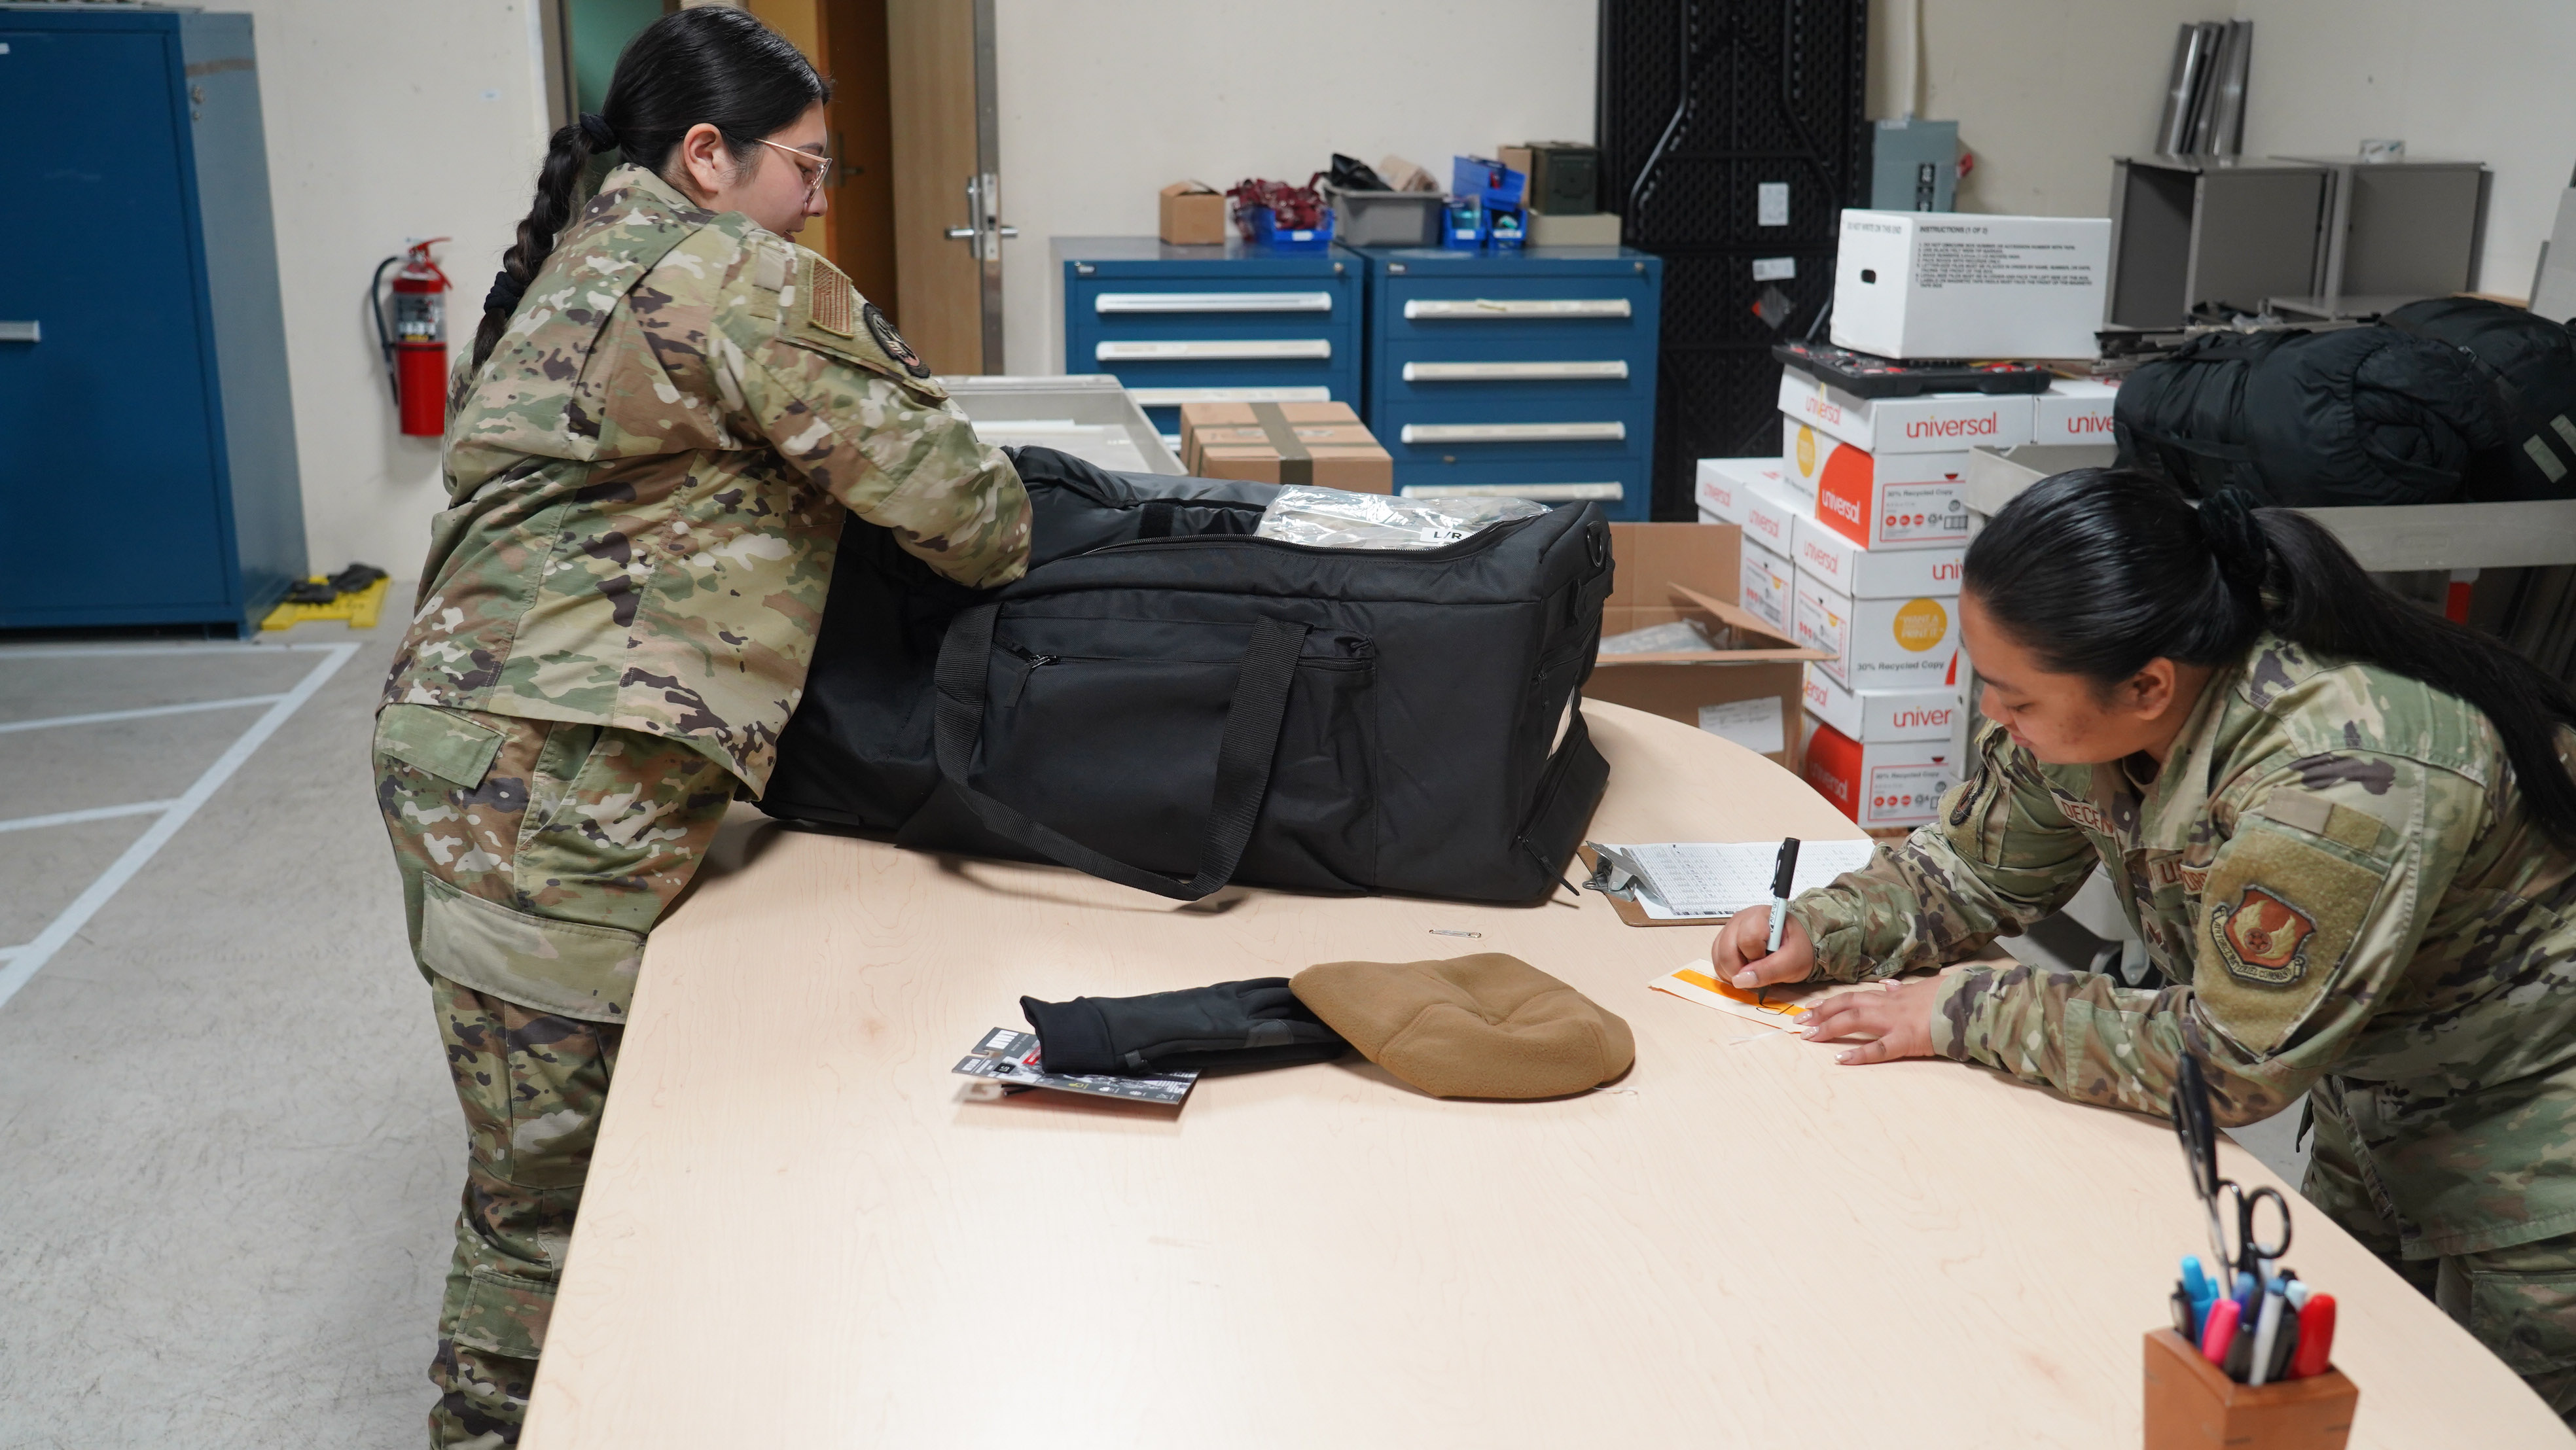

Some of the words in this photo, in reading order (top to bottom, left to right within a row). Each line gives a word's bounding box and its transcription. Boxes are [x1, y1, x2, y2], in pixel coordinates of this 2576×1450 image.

[1806, 395, 1841, 425] universal
[2068, 411, 2114, 433] unive
[1906, 411, 1997, 438] universal
[1822, 488, 1861, 525] universal
[1804, 540, 1838, 575] universal
[1932, 558, 1964, 580] uni
[1857, 662, 1875, 671] 30%
[1878, 661, 1919, 671] Recycled
[1921, 660, 1944, 669] Copy
[1804, 681, 1828, 707] ersal
[1893, 706, 1952, 728] univer
